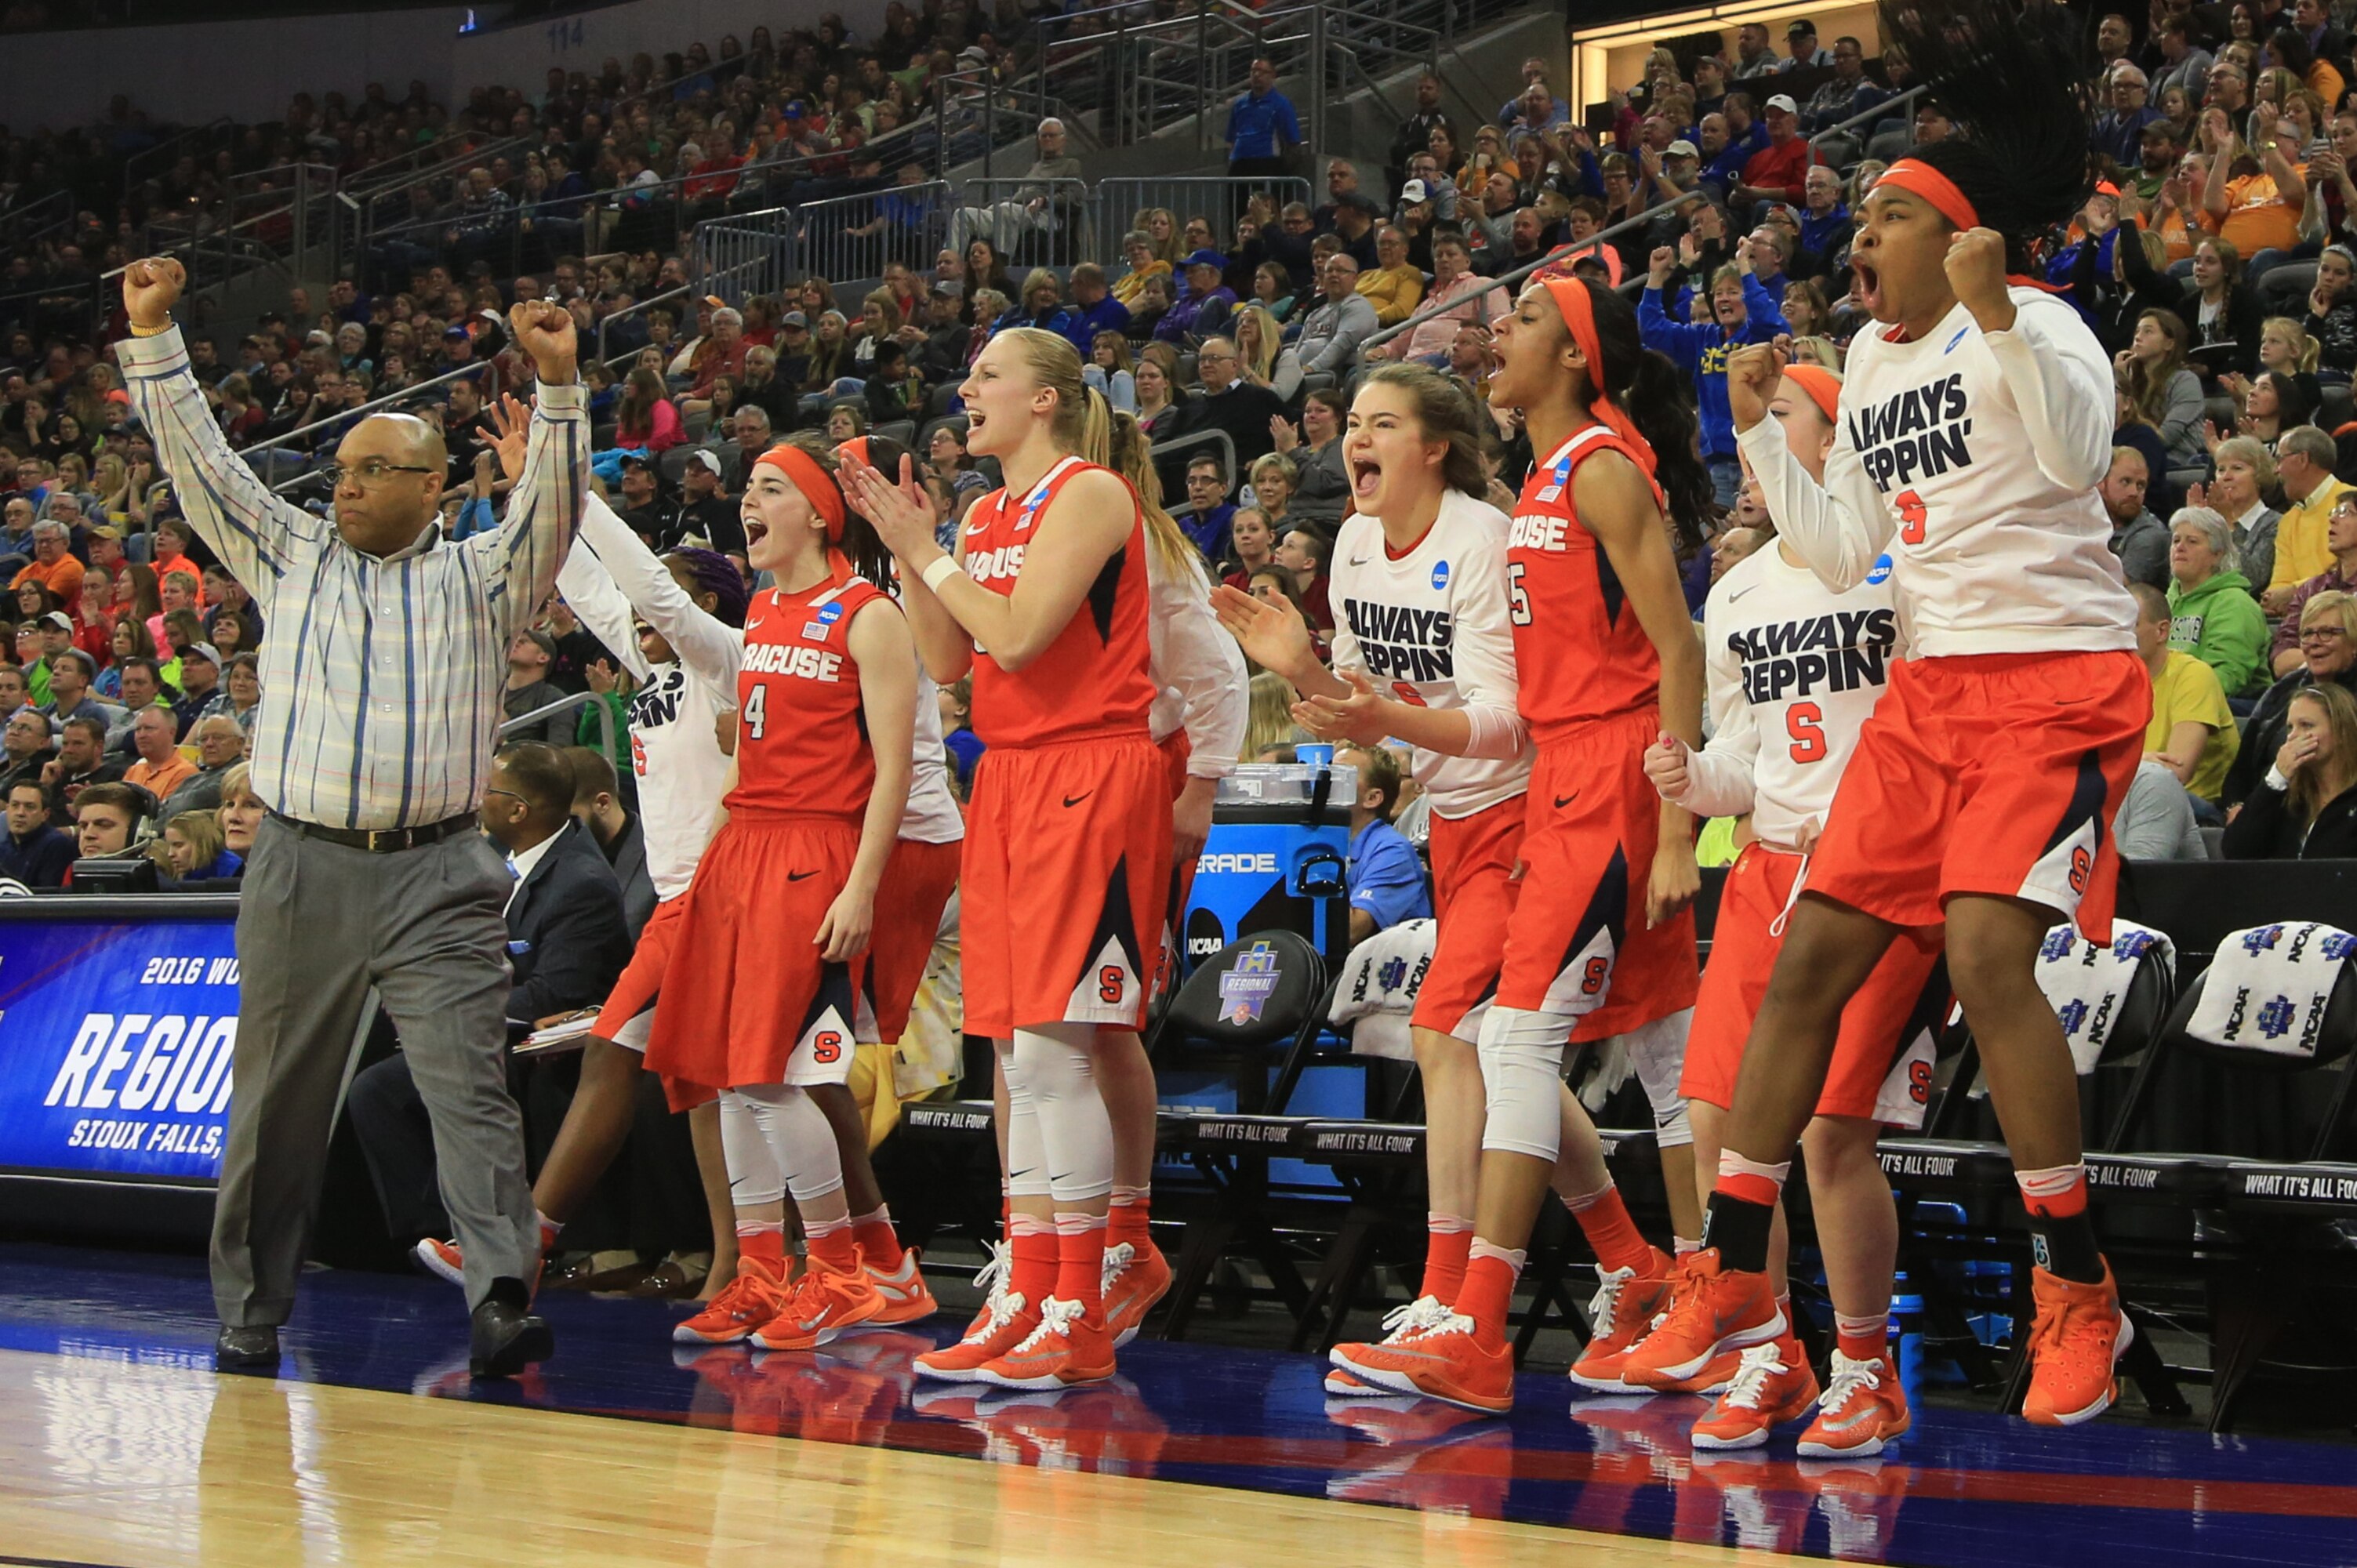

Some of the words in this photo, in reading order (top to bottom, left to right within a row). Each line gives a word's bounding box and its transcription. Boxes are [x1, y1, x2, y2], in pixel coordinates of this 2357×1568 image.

[1344, 598, 1452, 648] ALWAYS
[1727, 609, 1896, 663] ALWAYS
[744, 683, 767, 740] 4
[1785, 701, 1828, 764] S
[1188, 938, 1222, 955] NCAA
[140, 957, 205, 985] 2016
[1099, 964, 1124, 1004] S
[1226, 978, 1272, 991] REGIONAL
[1582, 956, 1607, 995] S
[2087, 993, 2116, 1046] NCAA
[2224, 988, 2250, 1041] NCAA
[2299, 995, 2326, 1051] NCAA
[813, 1030, 841, 1064] S
[1908, 1058, 1931, 1104] S
[910, 1110, 934, 1125] WHAT
[933, 1112, 950, 1127] IT'S
[950, 1113, 964, 1127] ALL
[965, 1114, 989, 1129] FOUR
[1199, 1123, 1226, 1138] WHAT
[1226, 1123, 1244, 1140] IT'S
[1245, 1126, 1261, 1141] ALL
[1262, 1127, 1287, 1142] FOUR
[67, 1119, 149, 1150] SIOUX
[146, 1123, 223, 1160] FALLS,
[1317, 1134, 1346, 1150] WHAT
[1346, 1134, 1365, 1151] IT'S
[1367, 1136, 1384, 1152] ALL
[1385, 1137, 1412, 1153] FOUR
[1881, 1155, 1901, 1173] IT'S
[1903, 1156, 1922, 1174] ALL
[1924, 1158, 1954, 1176] FOUR
[2100, 1166, 2119, 1185] ALL
[2123, 1168, 2156, 1188] FOUR
[2244, 1175, 2283, 1194] WHAT
[2283, 1177, 2308, 1196] IT'S
[2311, 1178, 2333, 1199] ALL
